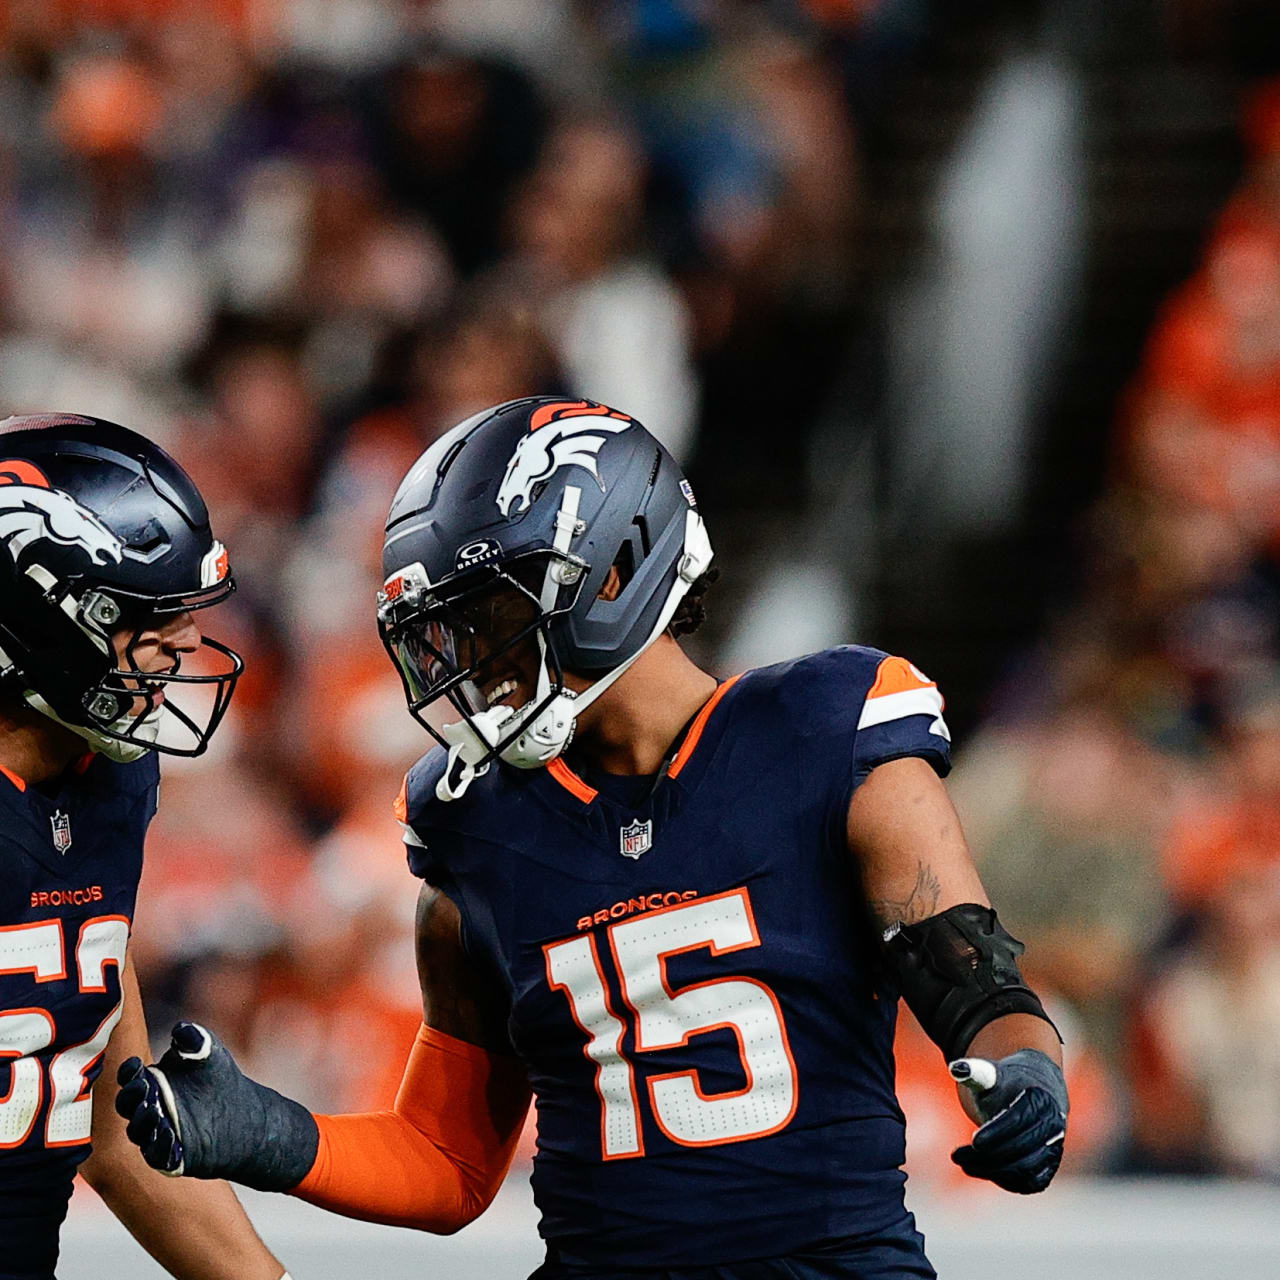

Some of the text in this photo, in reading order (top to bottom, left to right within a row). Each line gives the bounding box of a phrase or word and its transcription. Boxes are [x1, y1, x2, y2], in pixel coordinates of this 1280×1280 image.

[457, 548, 500, 570] OAKLEY
[625, 835, 648, 852] NFL
[30, 885, 103, 907] BRONCOS
[542, 886, 799, 1161] 15
